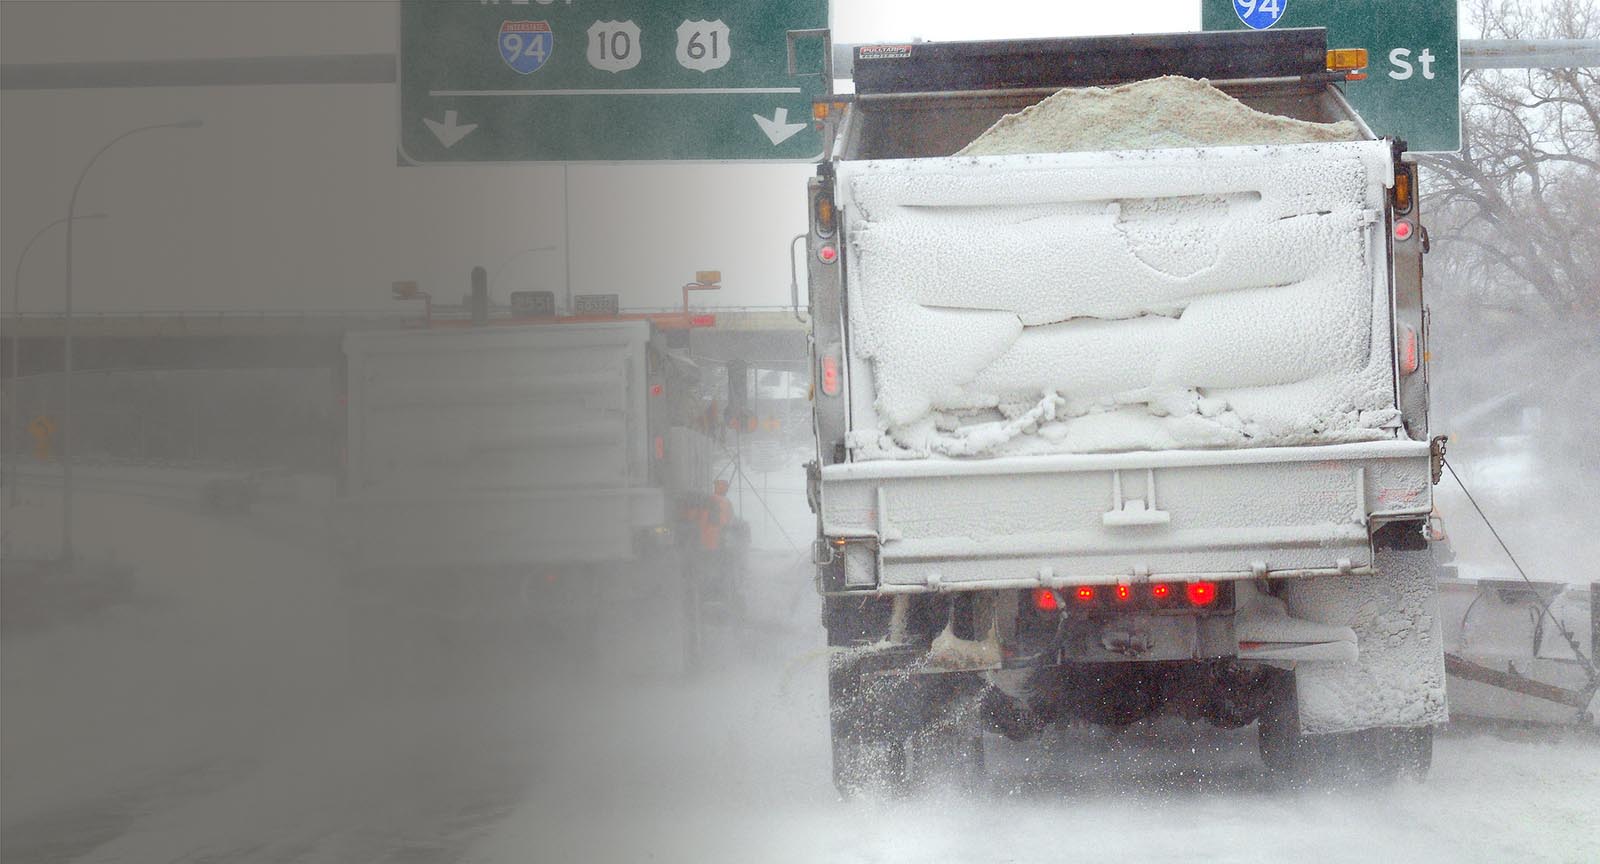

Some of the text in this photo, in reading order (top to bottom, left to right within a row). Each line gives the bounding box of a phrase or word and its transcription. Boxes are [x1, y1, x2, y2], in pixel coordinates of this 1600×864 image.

[1238, 0, 1280, 19] 94
[507, 23, 546, 31] INTERSTATE
[504, 33, 545, 64] 94
[598, 31, 630, 60] 10
[687, 31, 718, 59] 61
[1388, 47, 1436, 80] St
